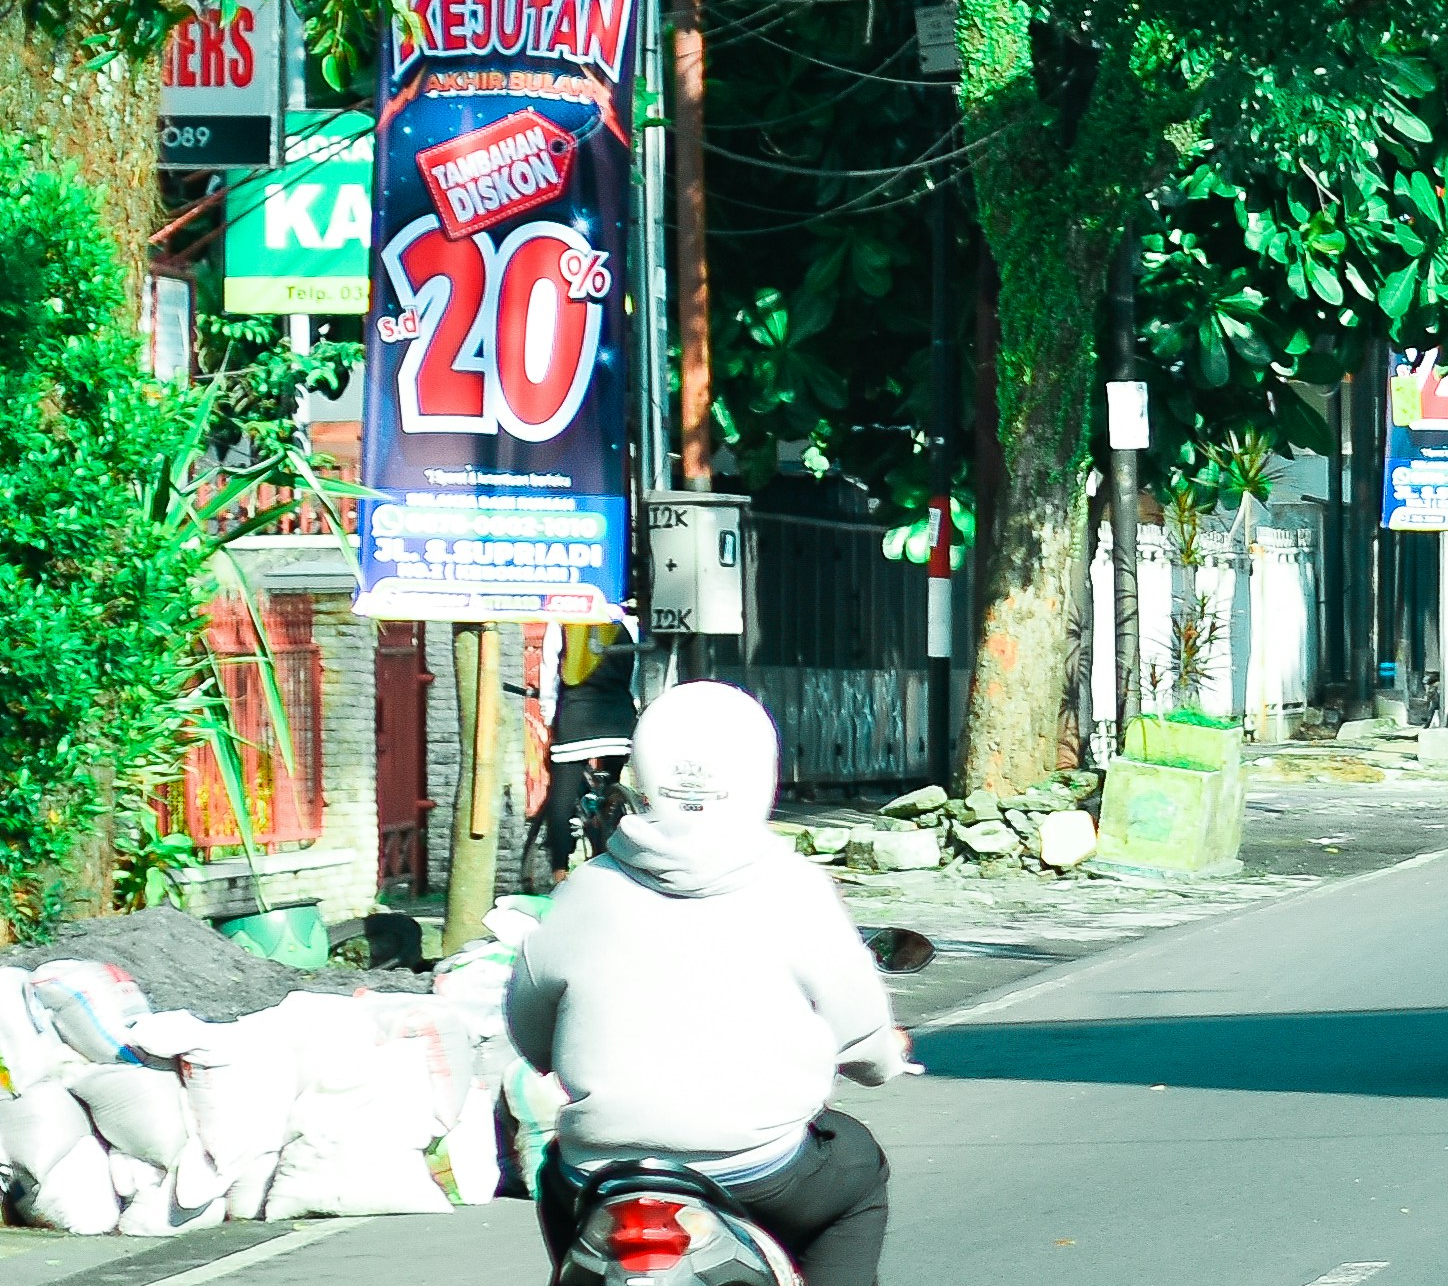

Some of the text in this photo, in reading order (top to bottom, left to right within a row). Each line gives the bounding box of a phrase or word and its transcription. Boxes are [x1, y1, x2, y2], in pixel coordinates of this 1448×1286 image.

[426, 72, 503, 95] AKHIR
[435, 126, 548, 187] TAMBAHAN
[447, 158, 557, 223] DISKON
[338, 285, 371, 301] 03
